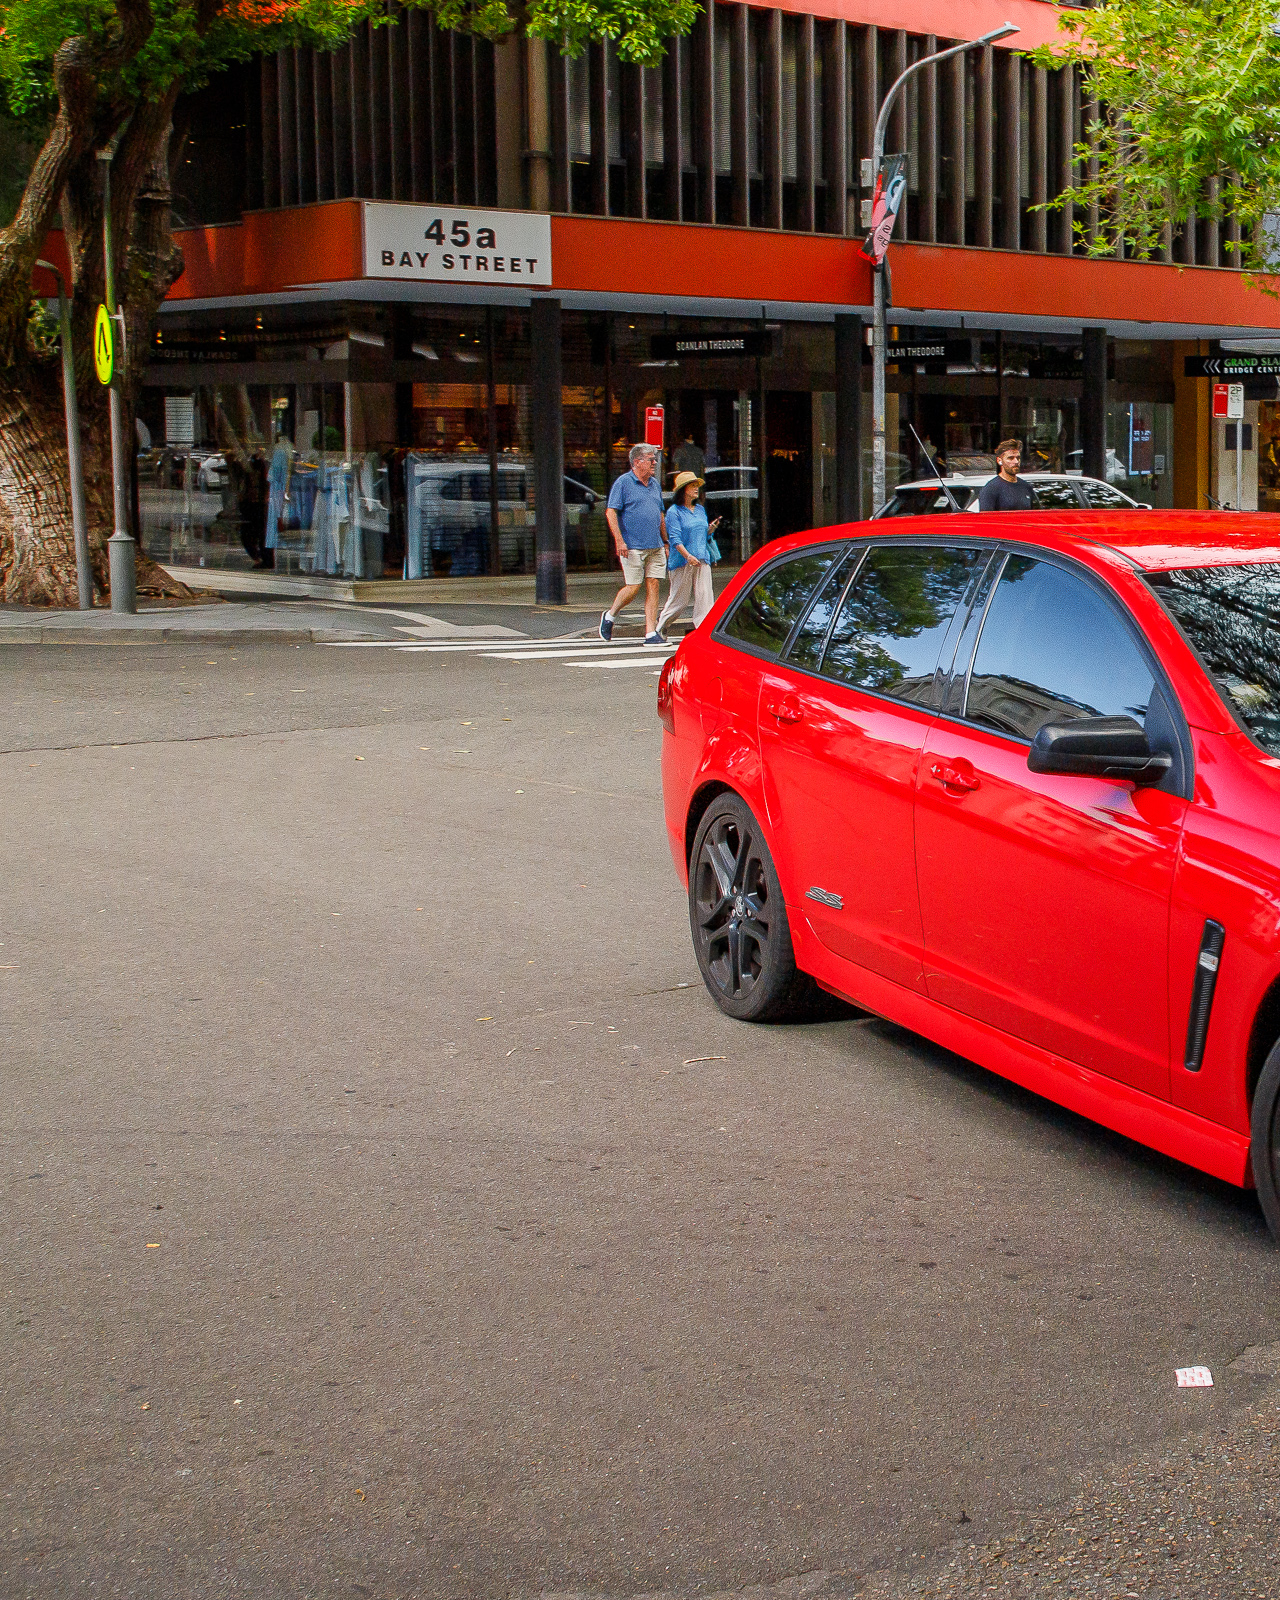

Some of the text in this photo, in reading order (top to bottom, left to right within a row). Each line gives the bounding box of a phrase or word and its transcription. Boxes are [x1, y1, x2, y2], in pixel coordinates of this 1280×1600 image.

[424, 218, 497, 249] 45a
[381, 250, 538, 274] BAY STREET
[675, 339, 744, 351] SCANLAN THEODORE
[907, 346, 945, 356] THEODORE
[1224, 358, 1258, 367] GRAND
[1224, 366, 1254, 374] BRIDGE
[1230, 386, 1242, 395] 2P
